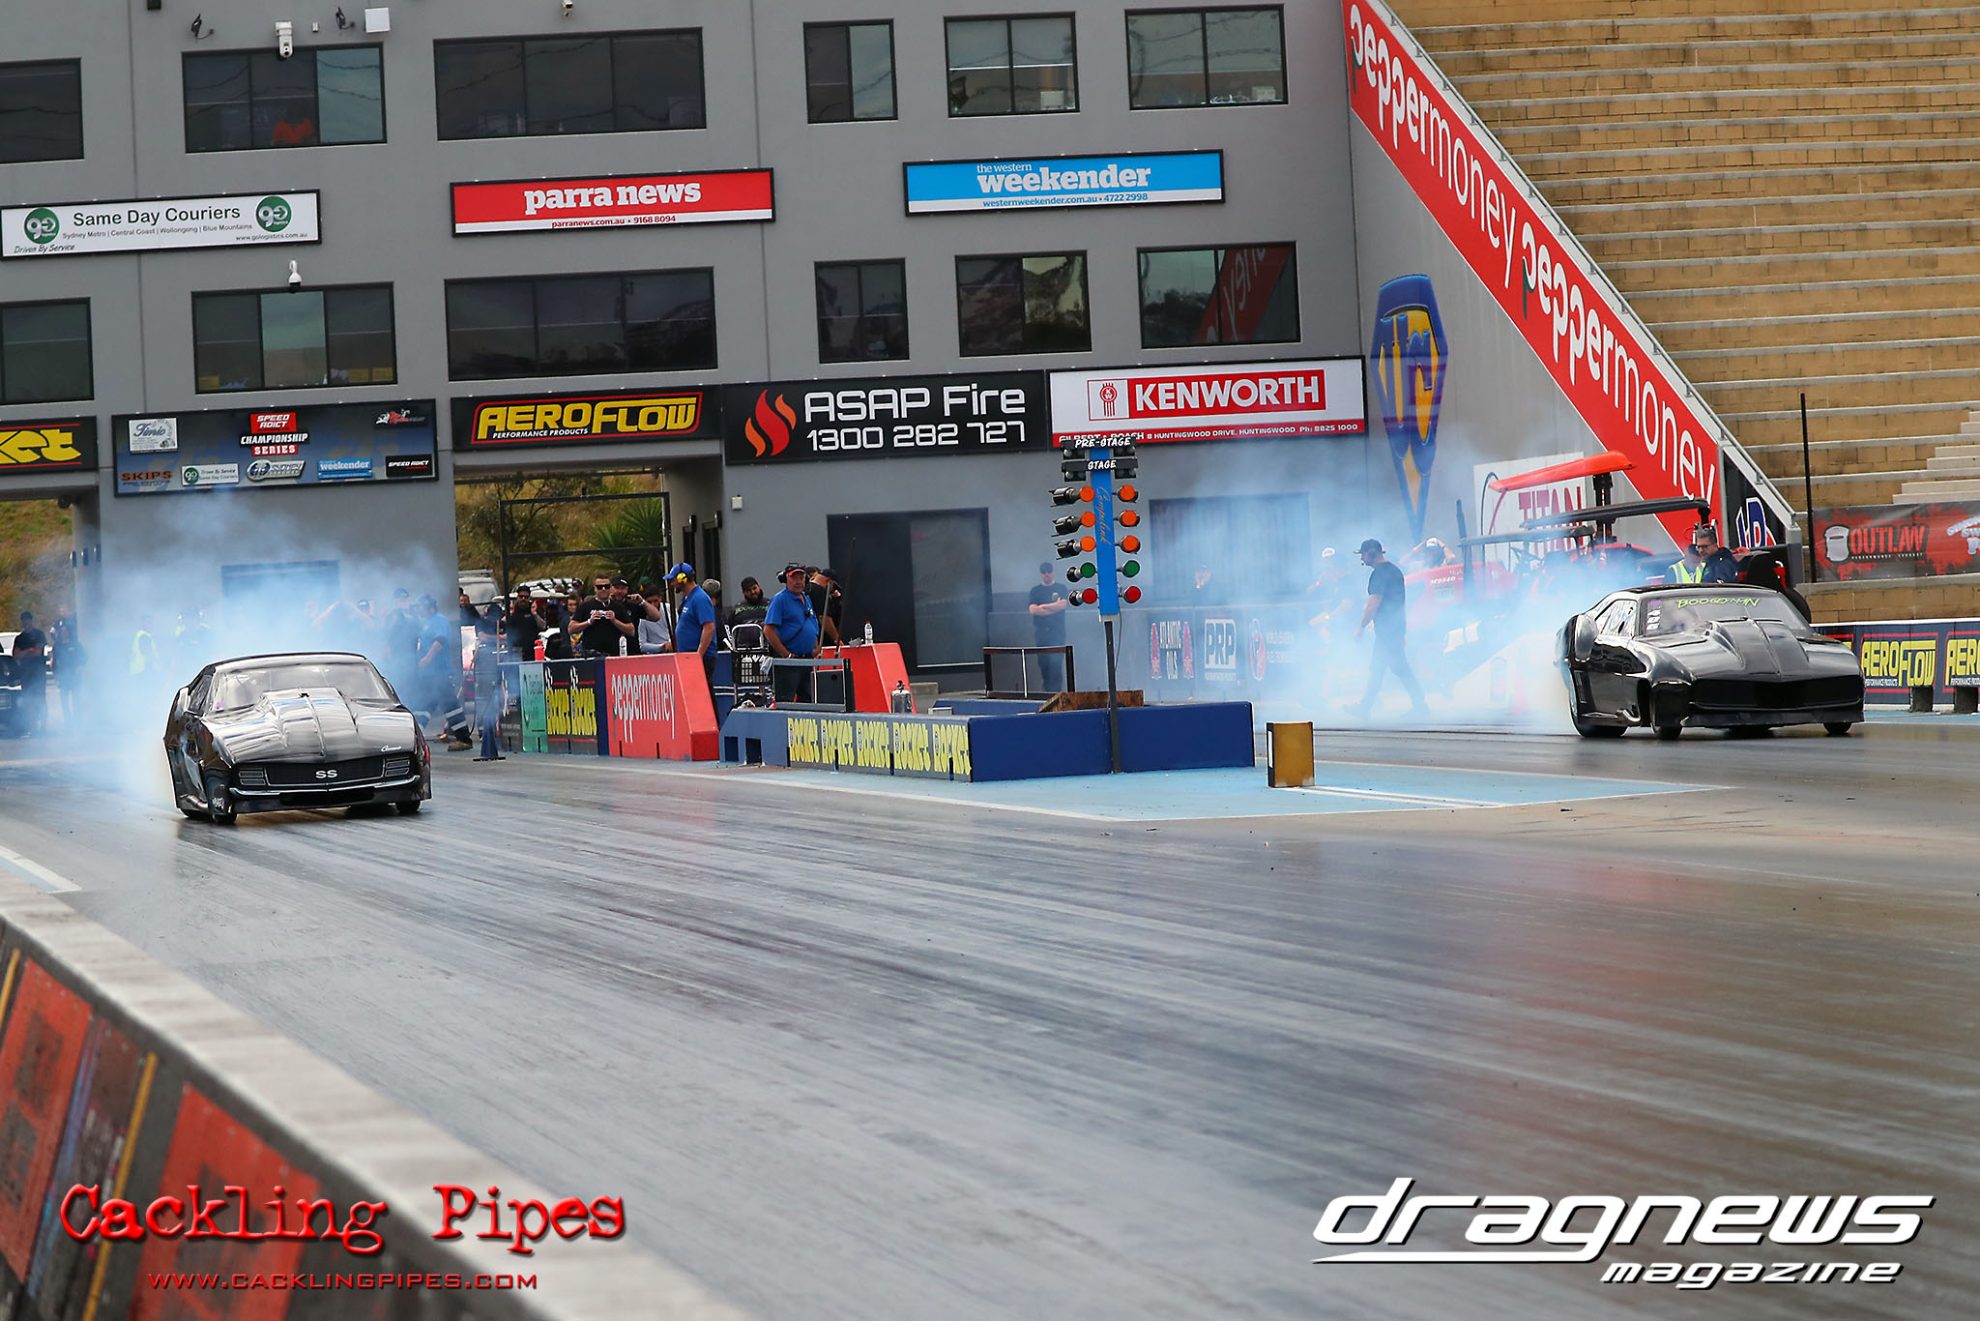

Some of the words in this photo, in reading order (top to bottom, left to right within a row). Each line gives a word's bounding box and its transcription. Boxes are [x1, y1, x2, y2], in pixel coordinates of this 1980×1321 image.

[1350, 4, 1516, 289] peppermoney
[976, 163, 992, 172] the
[993, 162, 1032, 172] western
[977, 164, 1151, 193] weekender
[524, 186, 613, 215] parra
[617, 182, 701, 205] news
[982, 195, 1098, 208] westernweekender.com.au
[1103, 194, 1125, 203] 4722
[1125, 192, 1148, 202] 2998
[73, 212, 122, 226] Same
[127, 209, 160, 226] Day
[165, 206, 240, 222] Couriers
[551, 217, 625, 230] parranews.com.au
[633, 215, 654, 224] 9168
[655, 214, 676, 223] 8094
[62, 231, 86, 239] Sydney
[87, 230, 106, 238] Metro
[111, 229, 135, 237] Central
[136, 228, 155, 236] Coast
[161, 226, 199, 234] Wollongong
[219, 223, 252, 231] Mountains
[14, 245, 37, 253] Driven
[38, 244, 48, 253] By
[49, 243, 75, 252] Service
[1521, 222, 1715, 508] peppermoney
[1135, 376, 1320, 411] KENWORTH
[804, 387, 931, 423] ASAP
[943, 383, 1026, 416] Fire
[256, 414, 290, 422] SPEED
[259, 421, 288, 429] ADICT
[477, 397, 697, 439] AEROFLOW
[240, 433, 308, 445] CHAMPIONSHIP
[492, 430, 548, 439] PERFORMANCE
[549, 427, 588, 436] PRODUCTS
[806, 426, 884, 451] 1300
[893, 423, 959, 447] 282
[966, 420, 1026, 444] 727
[1154, 432, 1211, 440] HUNTINGWOOD
[1239, 426, 1296, 435] HUNTINGWOOD
[1338, 423, 1358, 431] 1000
[254, 445, 296, 455] SERIES
[1074, 436, 1131, 449] PRE-STAGE
[320, 460, 370, 471] weekender
[1087, 460, 1117, 471] STAGE
[121, 471, 173, 481] SKIPS
[1850, 525, 1926, 555] OUTLAW
[1861, 640, 1936, 687] AEROFLOW
[611, 674, 676, 743] peppermoney
[315, 769, 338, 779] SS
